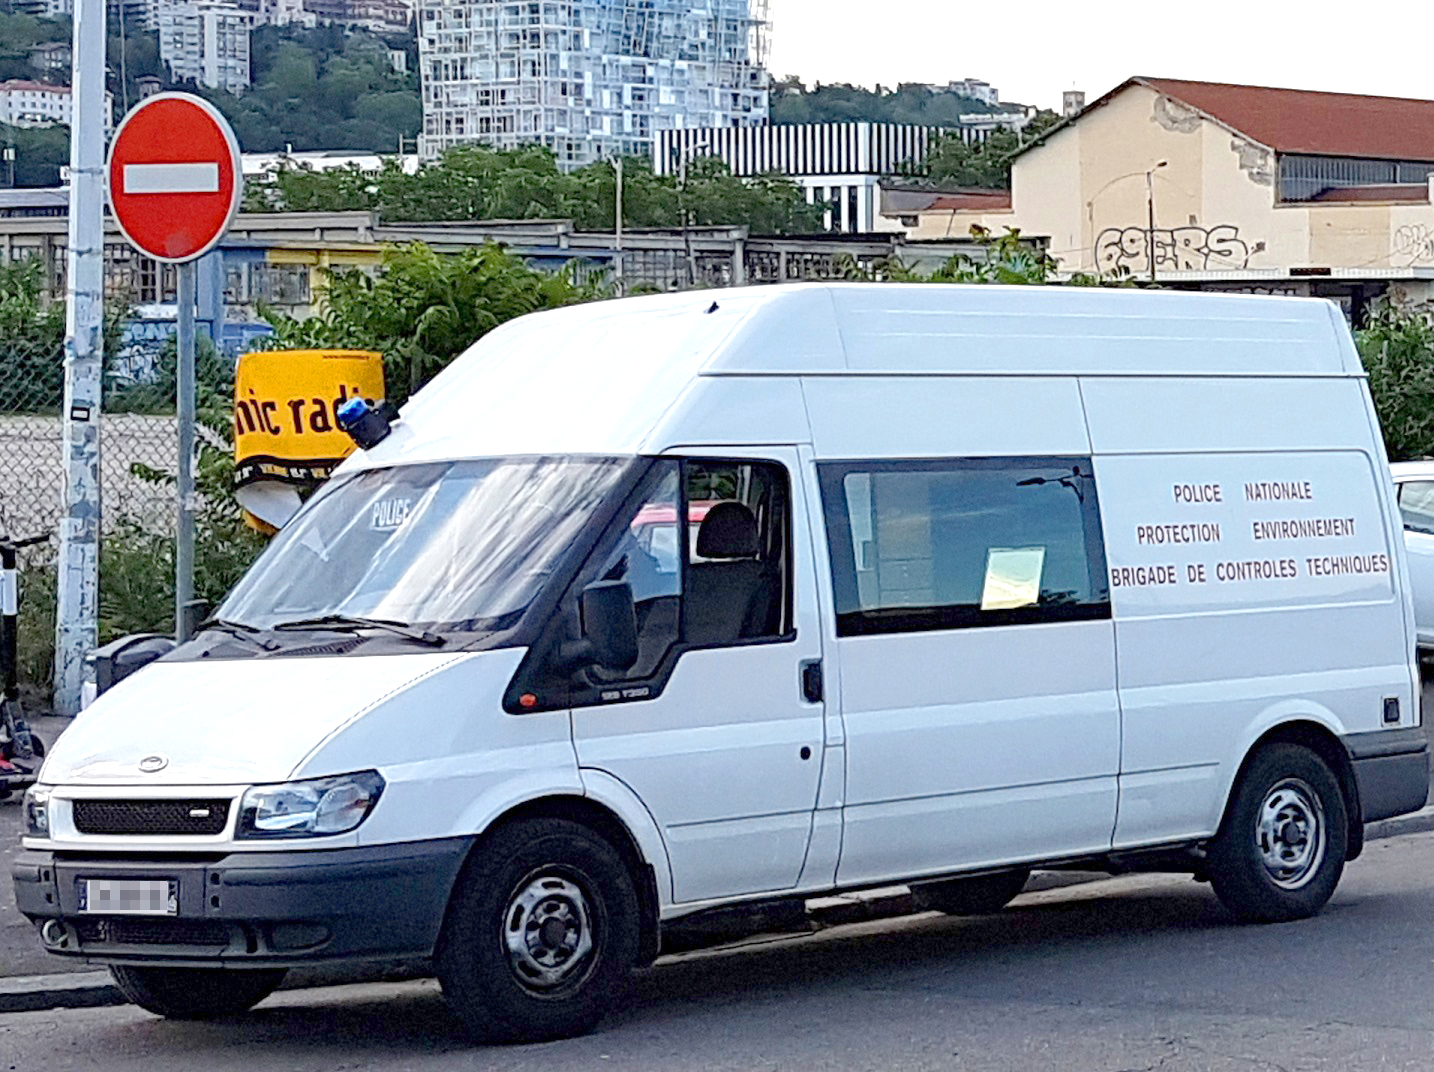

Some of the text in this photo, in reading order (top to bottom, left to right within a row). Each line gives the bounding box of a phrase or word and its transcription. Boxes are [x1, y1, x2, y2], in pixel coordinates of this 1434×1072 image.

[287, 384, 375, 434] rad
[1173, 482, 1312, 504] POLICE NATIONALE
[372, 499, 412, 526] POLICE
[1137, 518, 1355, 545] PROTECTION ENVIRONNEMENT
[1111, 554, 1388, 587] BRIGADE DE CONTROLES TECHNIQUES
